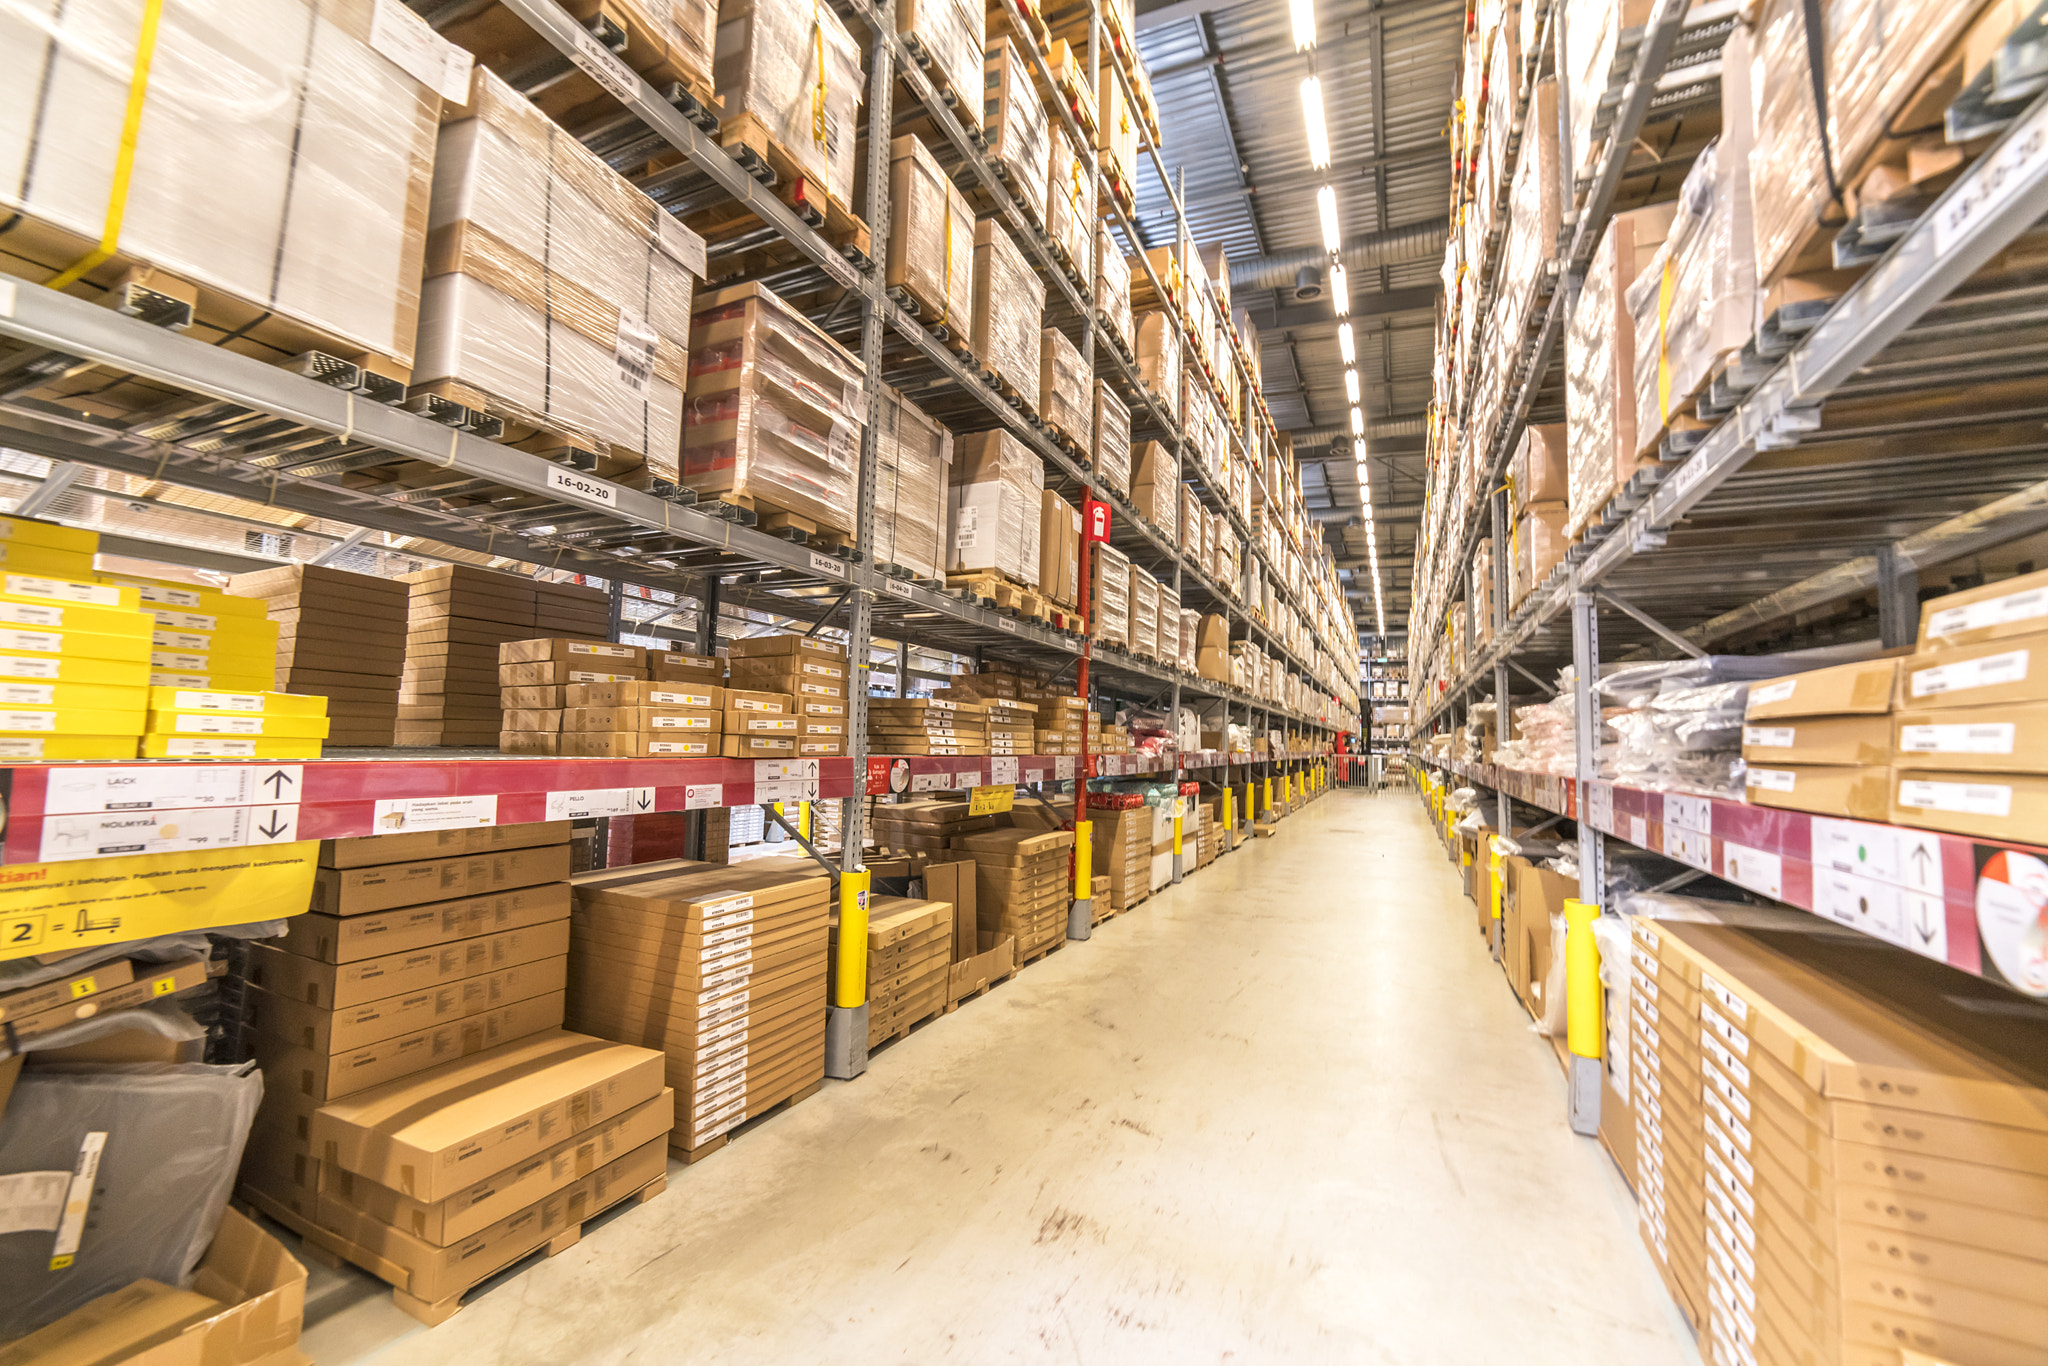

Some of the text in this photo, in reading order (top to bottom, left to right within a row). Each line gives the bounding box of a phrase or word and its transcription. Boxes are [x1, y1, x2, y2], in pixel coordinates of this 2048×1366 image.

[585, 40, 633, 86] 16-02-30
[557, 475, 609, 499] 16-02-20
[815, 558, 841, 572] 16-03-20
[107, 777, 137, 785] LACK
[11, 923, 32, 942] 2
[80, 984, 89, 993] 1
[161, 983, 169, 992] 1
